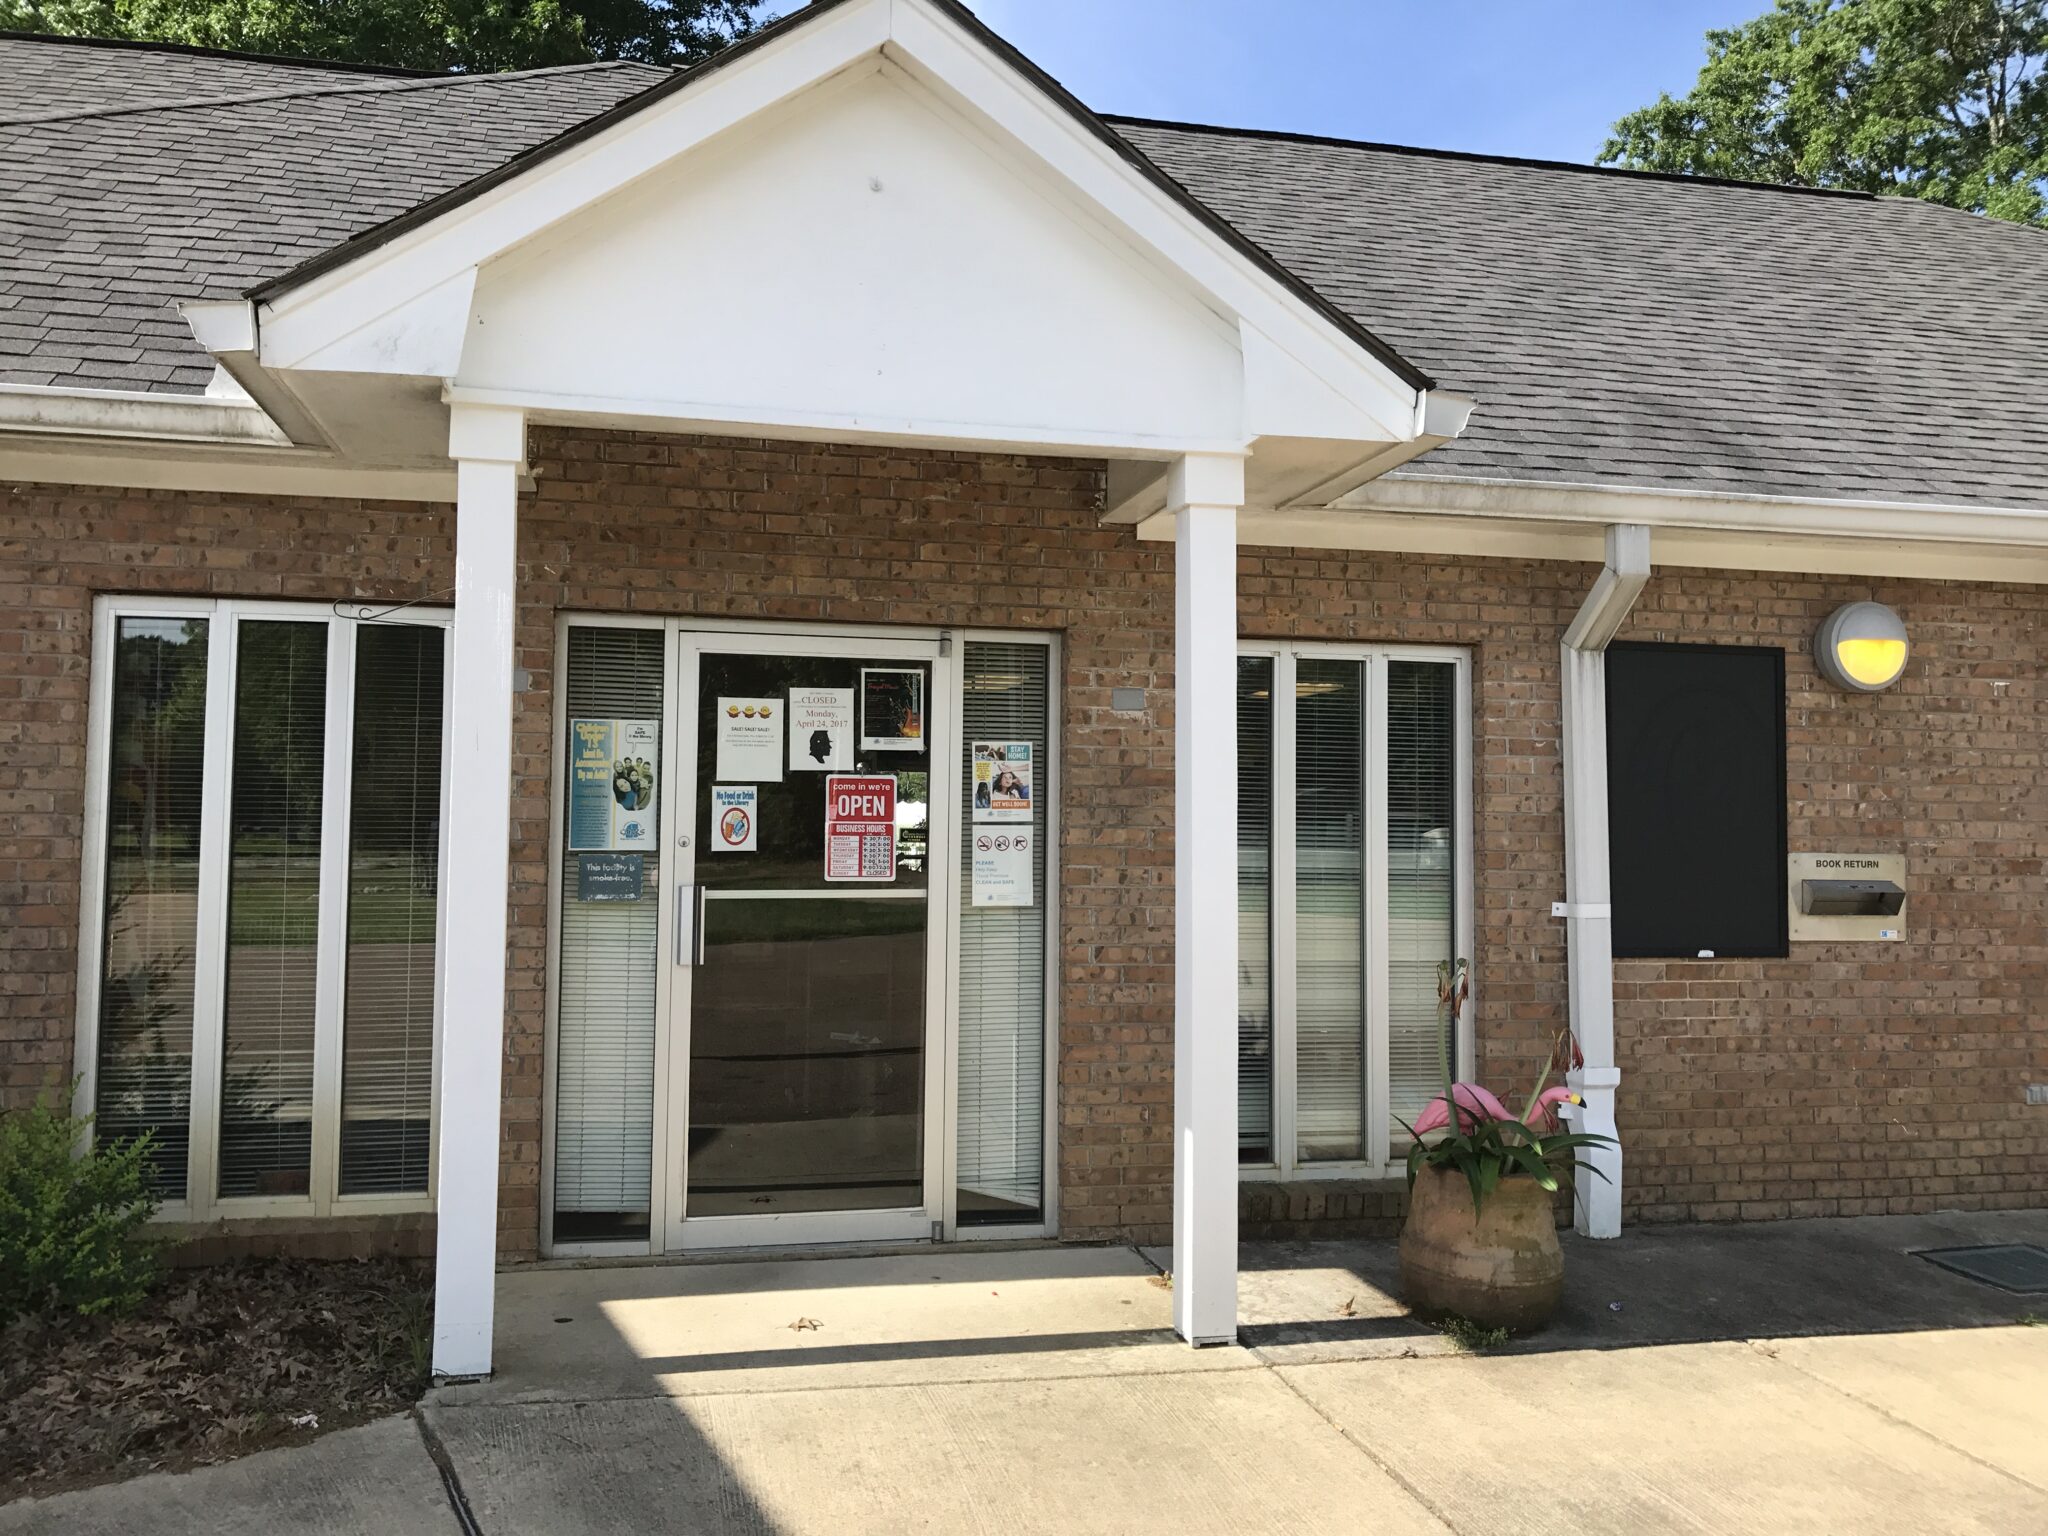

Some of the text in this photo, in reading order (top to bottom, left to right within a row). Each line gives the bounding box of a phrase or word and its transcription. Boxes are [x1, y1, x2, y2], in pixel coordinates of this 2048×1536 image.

[801, 696, 837, 704] CLOSED
[805, 709, 838, 719] Monday,
[796, 719, 848, 728] April 24, 2017
[1008, 752, 1027, 760] HOME!
[858, 782, 866, 791] in
[868, 783, 891, 791] we're
[716, 791, 755, 800] No Food or Drink
[838, 794, 885, 817] OPEN
[836, 824, 886, 833] BUSINESS HOURS
[586, 862, 636, 874] This facility is
[1815, 859, 1879, 869] BOOK RETURN
